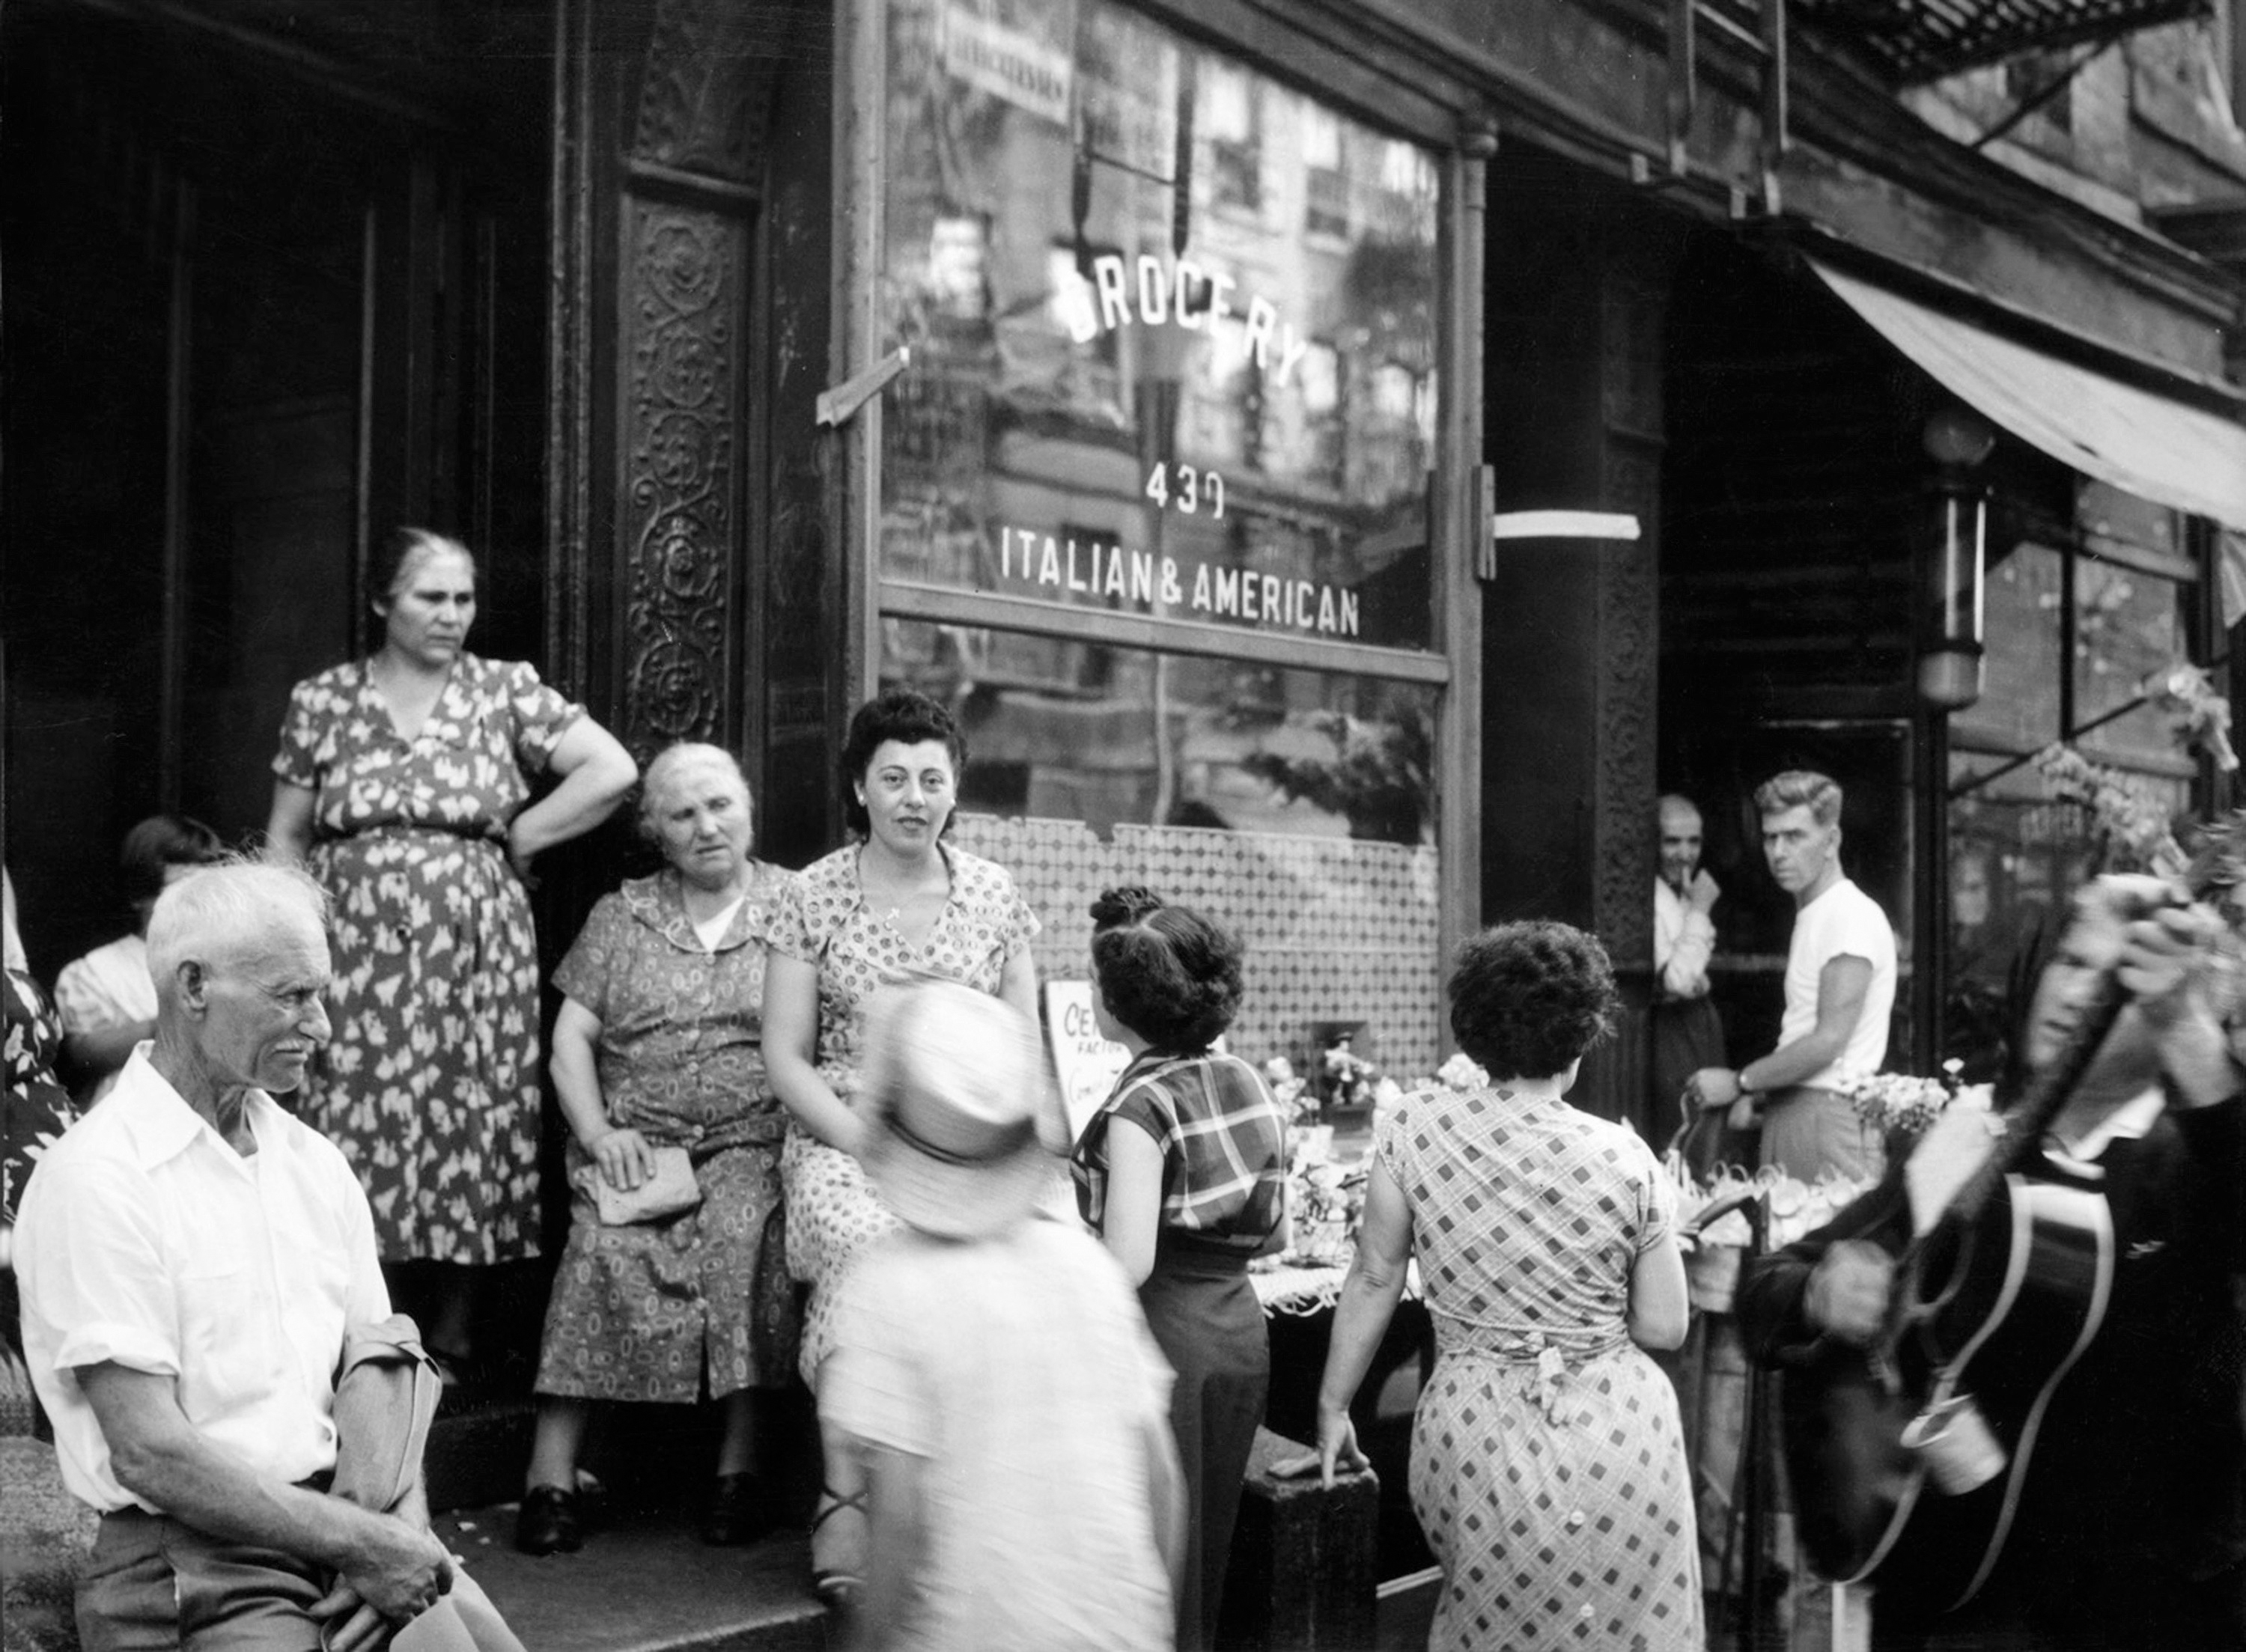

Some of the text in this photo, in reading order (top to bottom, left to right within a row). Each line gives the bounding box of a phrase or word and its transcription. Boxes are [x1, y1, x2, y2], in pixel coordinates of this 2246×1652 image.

[1001, 526, 1360, 635] ITALIAN & AMERICAN
